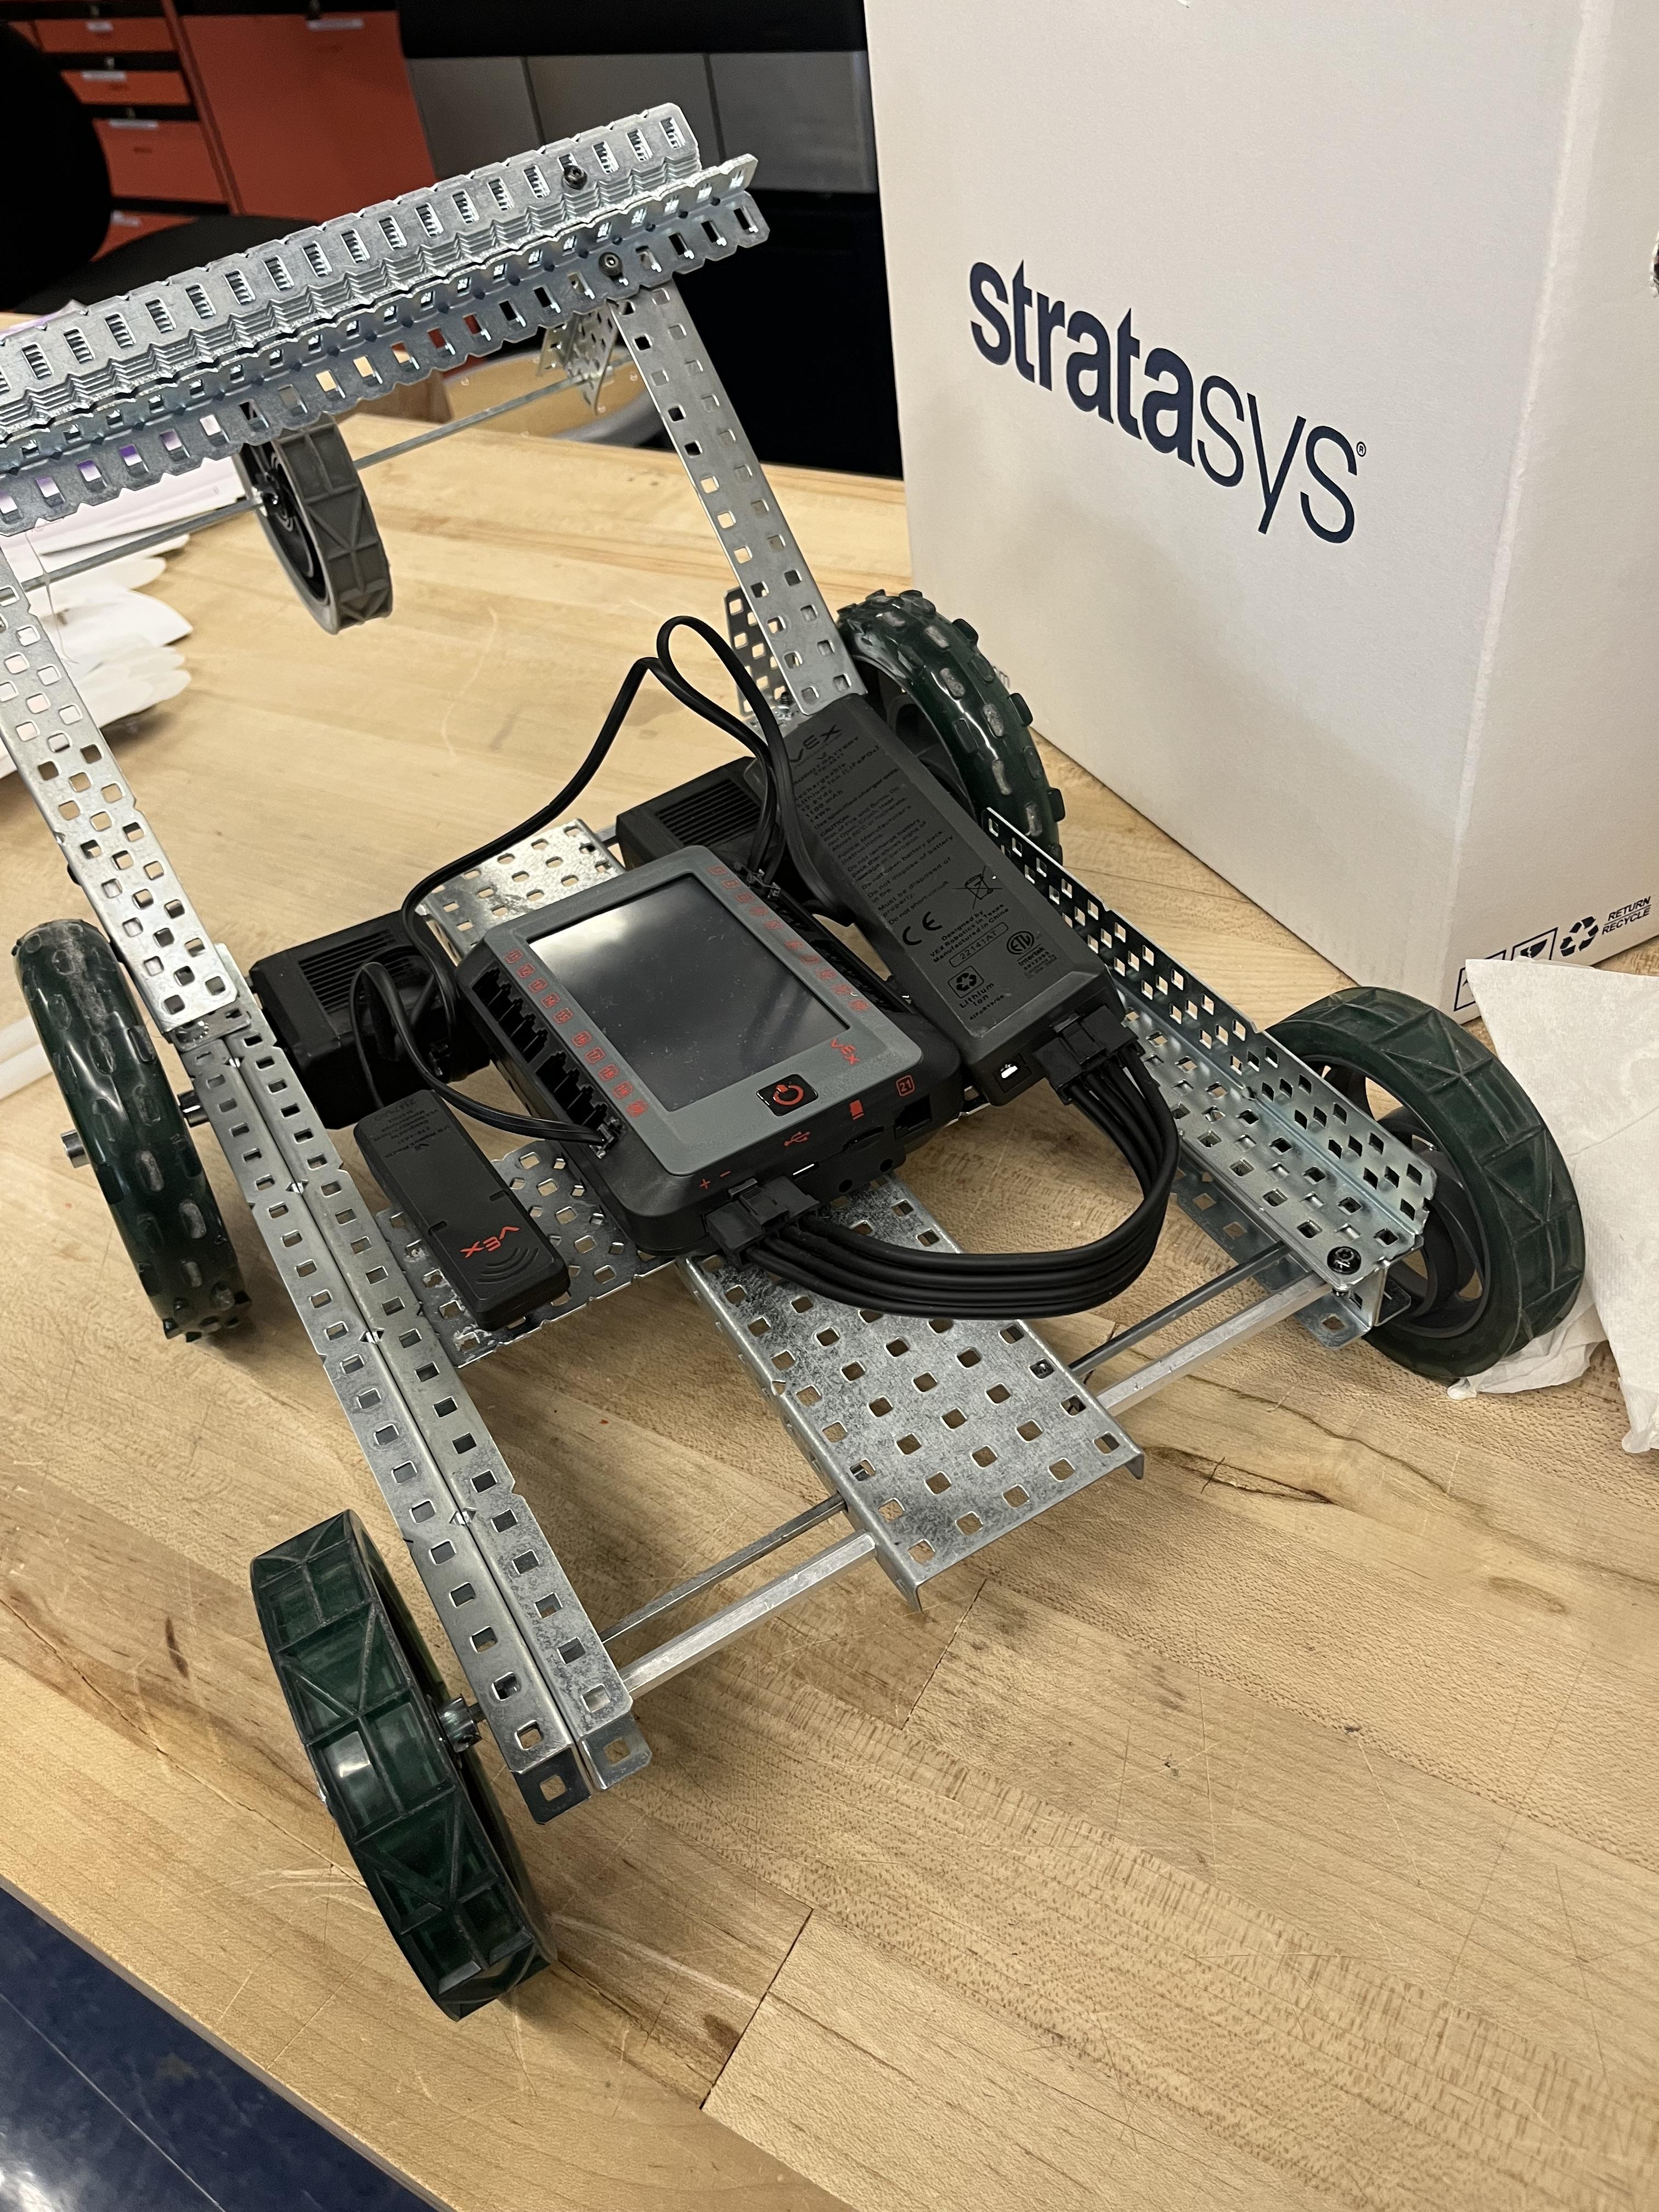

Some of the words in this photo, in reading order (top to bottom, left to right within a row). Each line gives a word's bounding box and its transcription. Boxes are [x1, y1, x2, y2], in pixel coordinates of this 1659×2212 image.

[847, 863, 857, 872] Do
[857, 855, 868, 865] not
[868, 834, 898, 857] recharge
[896, 819, 921, 837] battery
[851, 864, 868, 878] pack
[901, 826, 919, 842] signs
[861, 881, 872, 890] Do
[872, 872, 884, 882] not
[884, 860, 902, 874] open
[901, 843, 926, 862] battery
[867, 889, 878, 898] Do
[878, 879, 891, 890] not
[891, 860, 919, 882] dispose
[928, 835, 954, 855] battery
[877, 896, 896, 911] Must
[897, 888, 907, 897] be
[908, 863, 943, 890] disposed
[942, 856, 951, 865] of
[888, 916, 899, 925] Do
[898, 907, 910, 918] not
[1601, 908, 1650, 935] RECYCLE
[1607, 896, 1651, 922] RETURN
[929, 945, 945, 957] VEX
[944, 923, 975, 947] Robotics
[984, 903, 1004, 919] Texas
[932, 927, 981, 963] Manufactured
[988, 907, 1009, 924] China
[941, 916, 975, 942] Designed
[974, 910, 984, 918] by
[959, 929, 998, 960] 22141AT
[1018, 945, 1045, 966] Intertek
[959, 982, 994, 1008] Lithium
[972, 994, 989, 1006] Ion
[830, 1037, 860, 1066] VEX
[899, 1079, 912, 1092] 21
[460, 1226, 520, 1259] VEX
